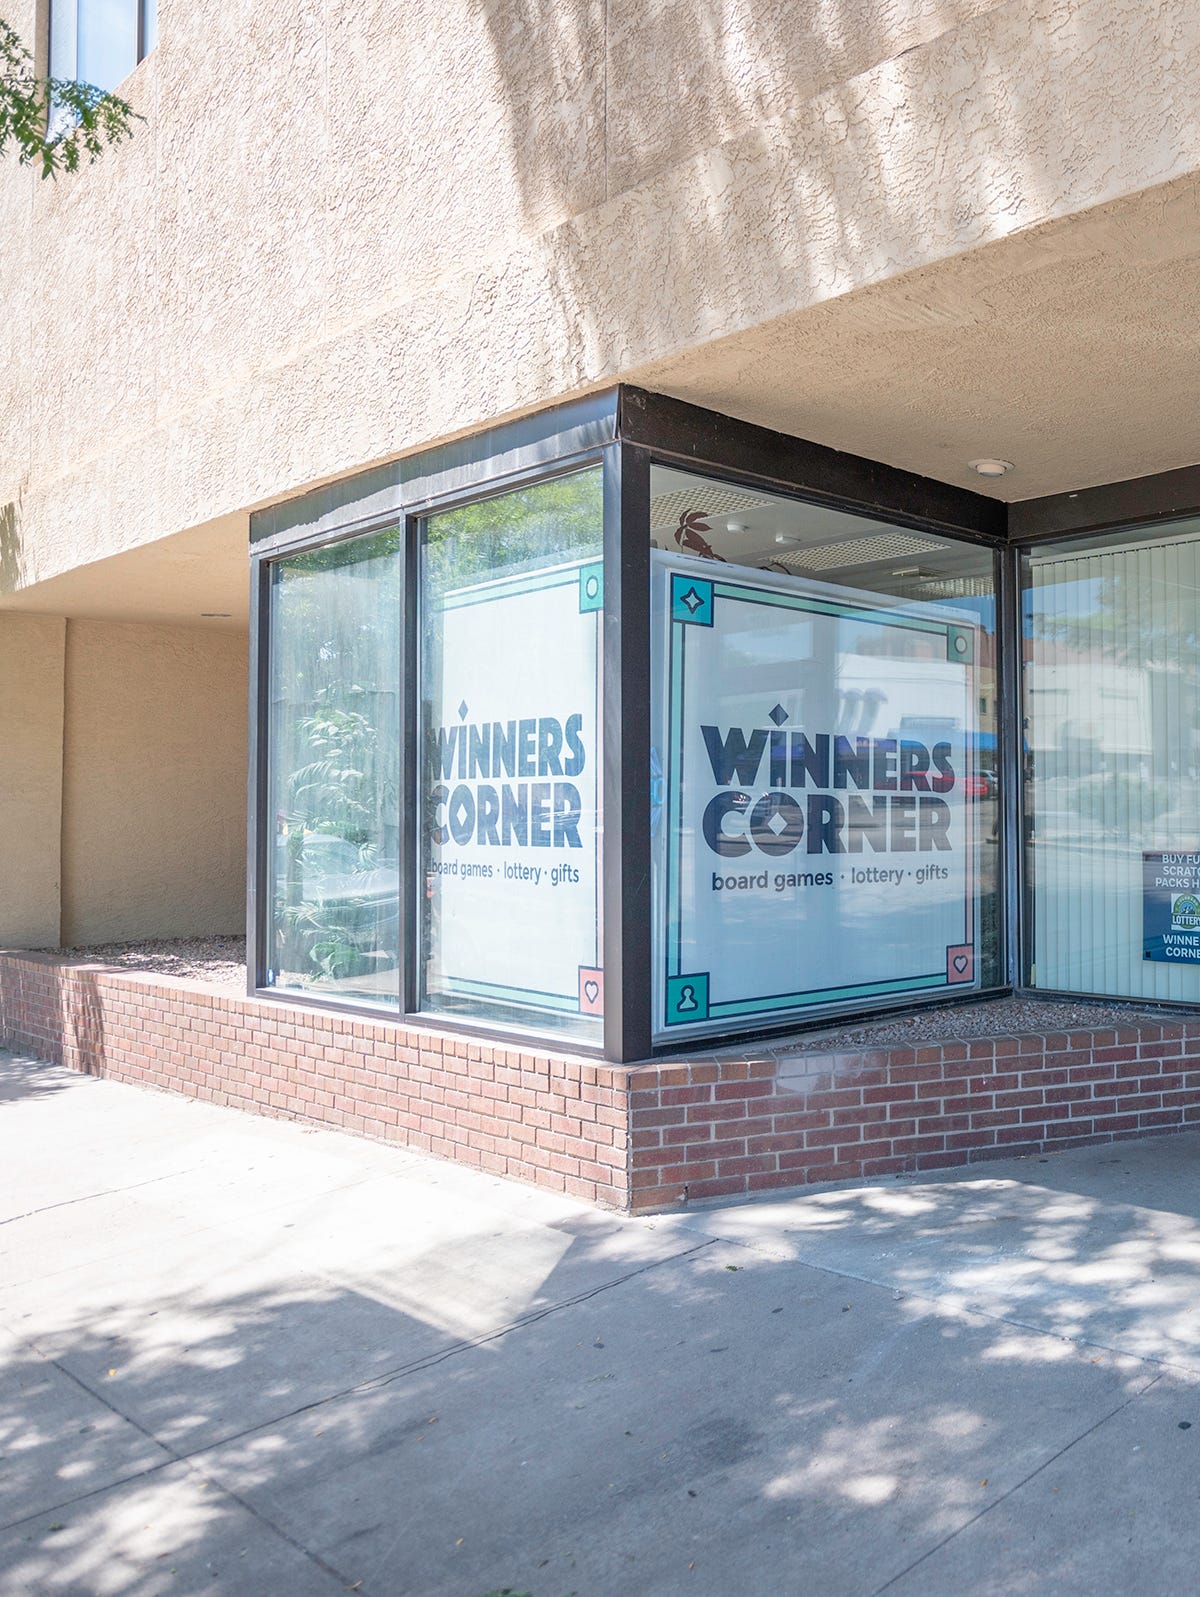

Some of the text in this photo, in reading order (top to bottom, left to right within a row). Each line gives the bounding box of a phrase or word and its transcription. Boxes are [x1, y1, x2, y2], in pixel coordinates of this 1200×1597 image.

[430, 699, 585, 781] WINNERS
[700, 704, 955, 793] WINNERS
[430, 782, 583, 848] CORNER
[702, 791, 952, 857] CORNER
[432, 859, 580, 887] board games lottery gifts
[712, 864, 948, 892] board games lottery gifts
[1155, 877, 1190, 888] PACKS
[1162, 854, 1184, 864] BUY
